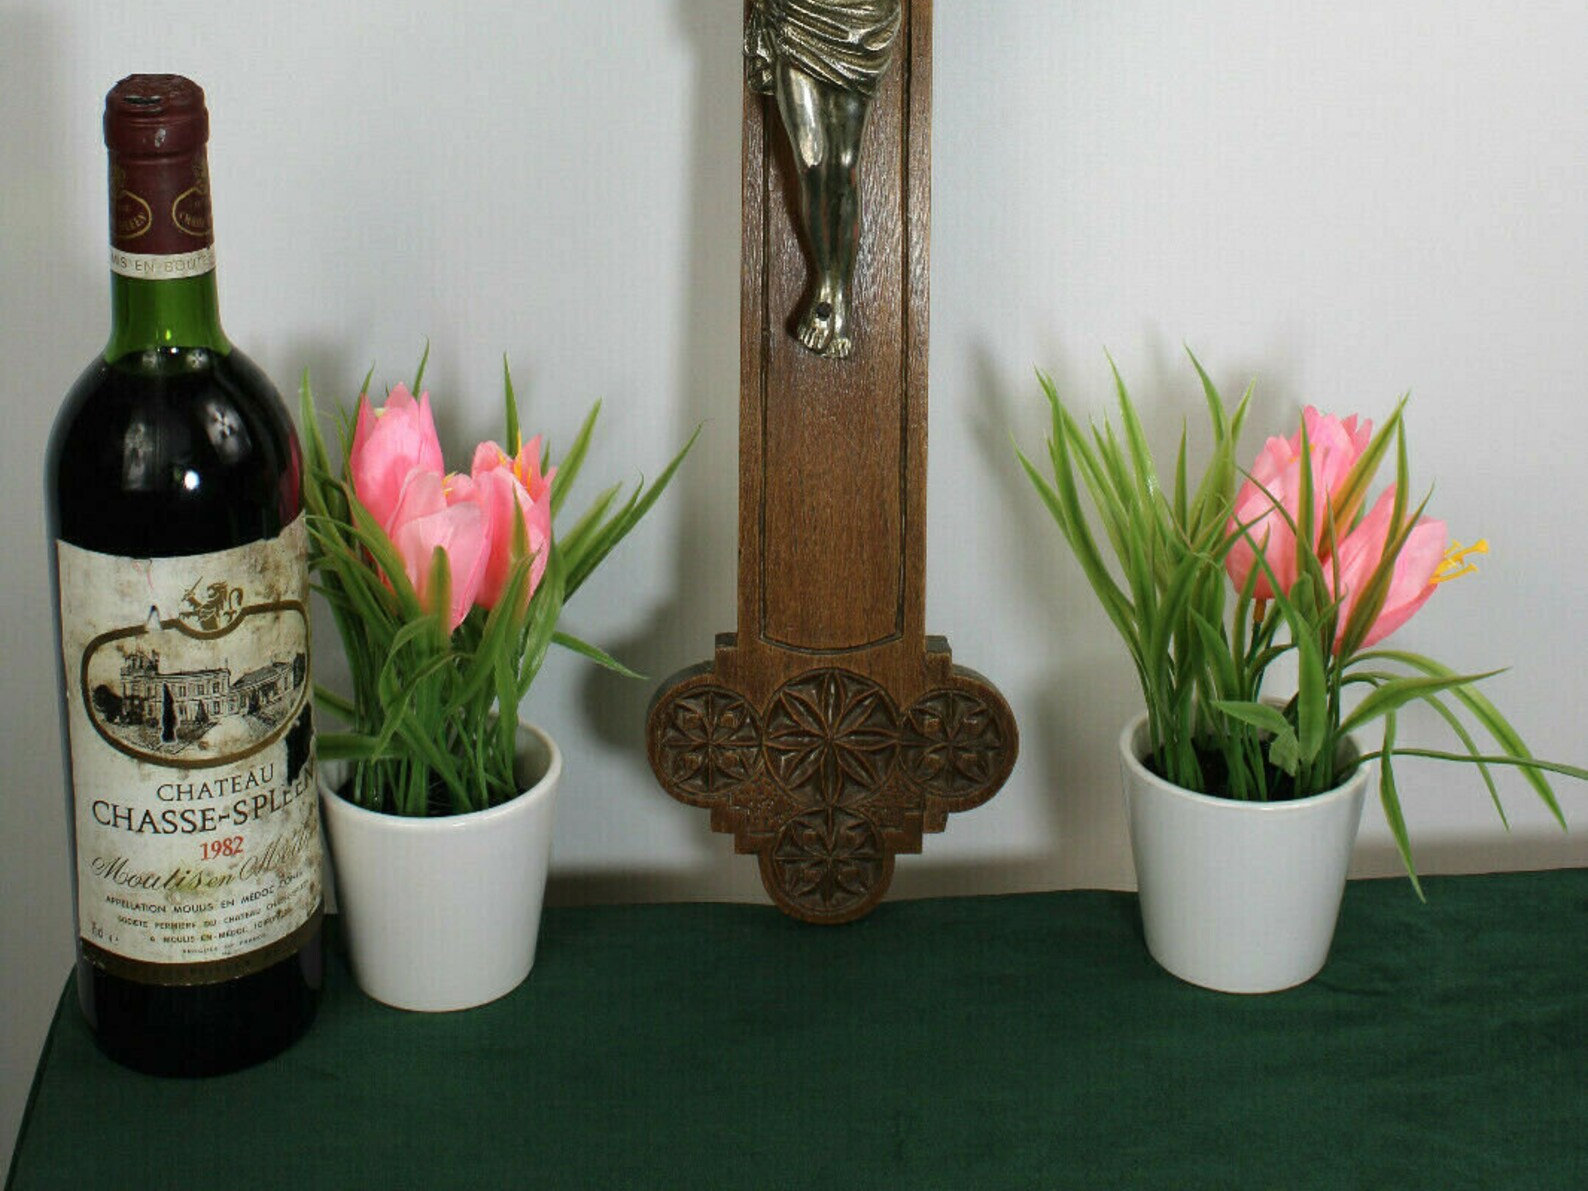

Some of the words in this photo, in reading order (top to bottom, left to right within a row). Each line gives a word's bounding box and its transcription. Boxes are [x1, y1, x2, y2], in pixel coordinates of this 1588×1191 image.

[135, 259, 154, 274] EN
[156, 763, 274, 802] CHATEAU
[200, 836, 245, 862] 1982
[106, 895, 167, 914] APPELLATION
[173, 902, 214, 914] MOULIS
[220, 899, 235, 909] EN
